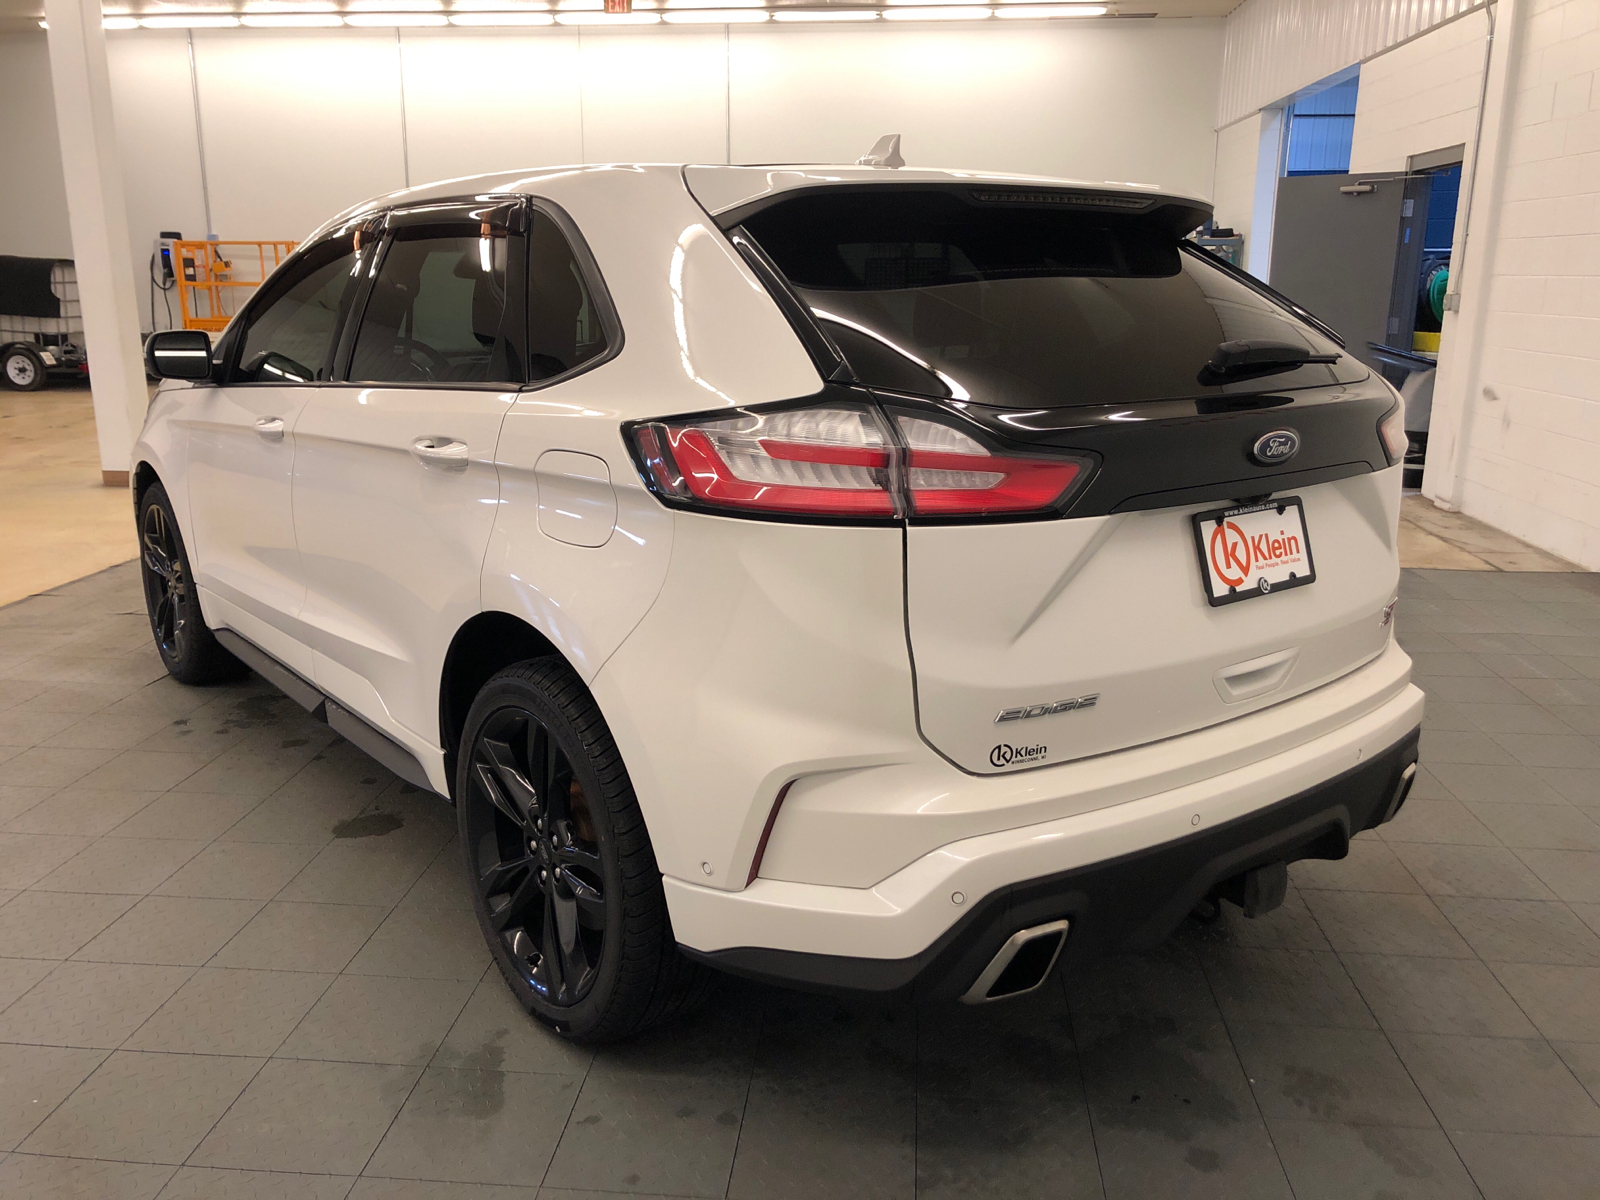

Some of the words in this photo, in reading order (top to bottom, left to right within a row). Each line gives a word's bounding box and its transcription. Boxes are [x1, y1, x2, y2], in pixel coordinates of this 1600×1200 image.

[1266, 437, 1291, 456] Ford
[1224, 502, 1278, 516] www.kleinauto.com
[1251, 530, 1300, 562] Klein
[1255, 563, 1265, 571] Real
[994, 693, 1100, 722] EDGE
[1015, 744, 1047, 758] Klein
